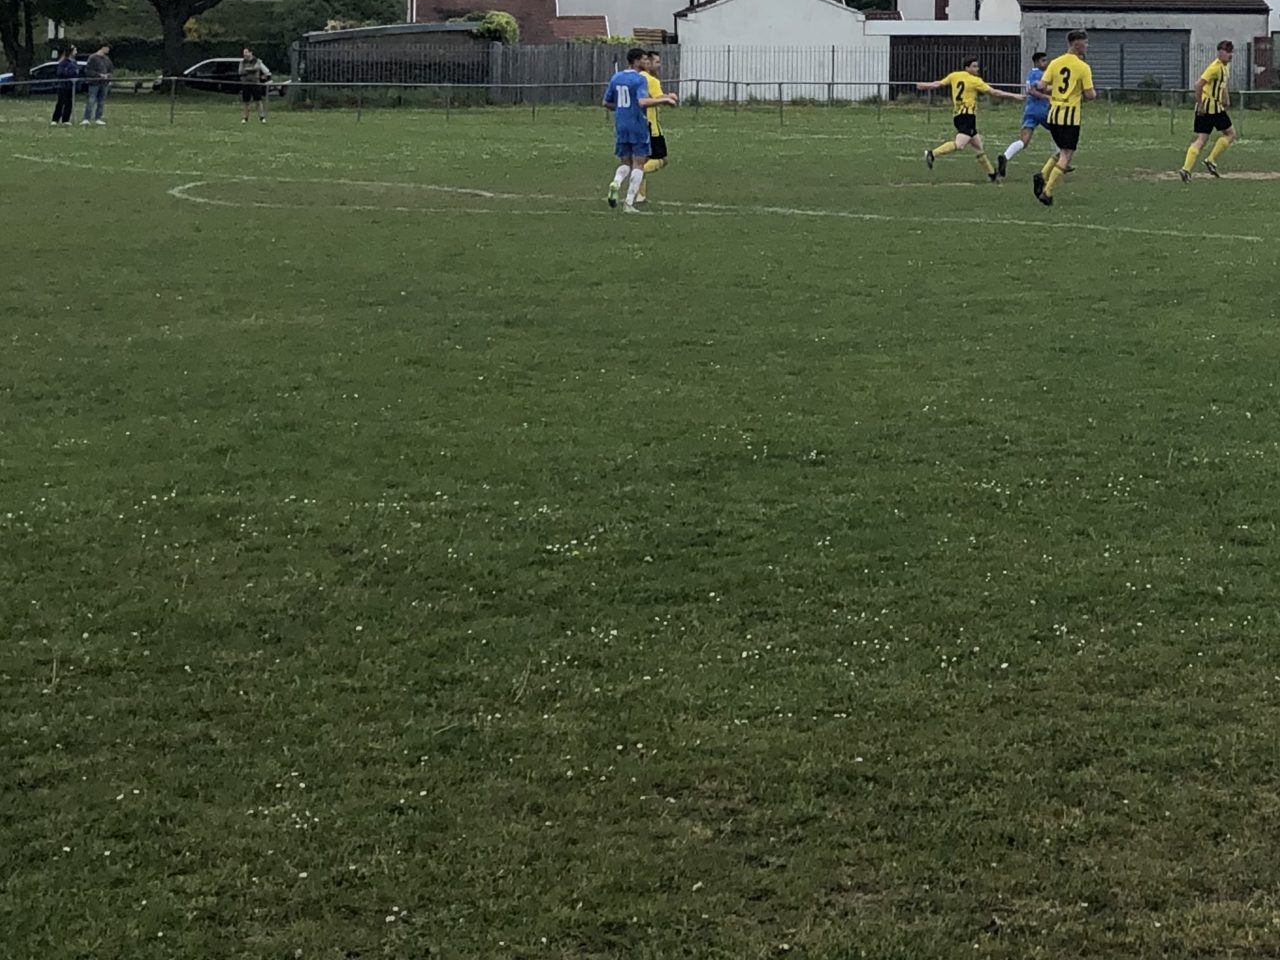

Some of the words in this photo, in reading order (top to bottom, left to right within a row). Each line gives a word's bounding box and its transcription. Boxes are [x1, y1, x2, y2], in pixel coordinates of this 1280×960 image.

[955, 81, 965, 101] 2
[1058, 66, 1071, 94] 3
[615, 85, 631, 107] 10
